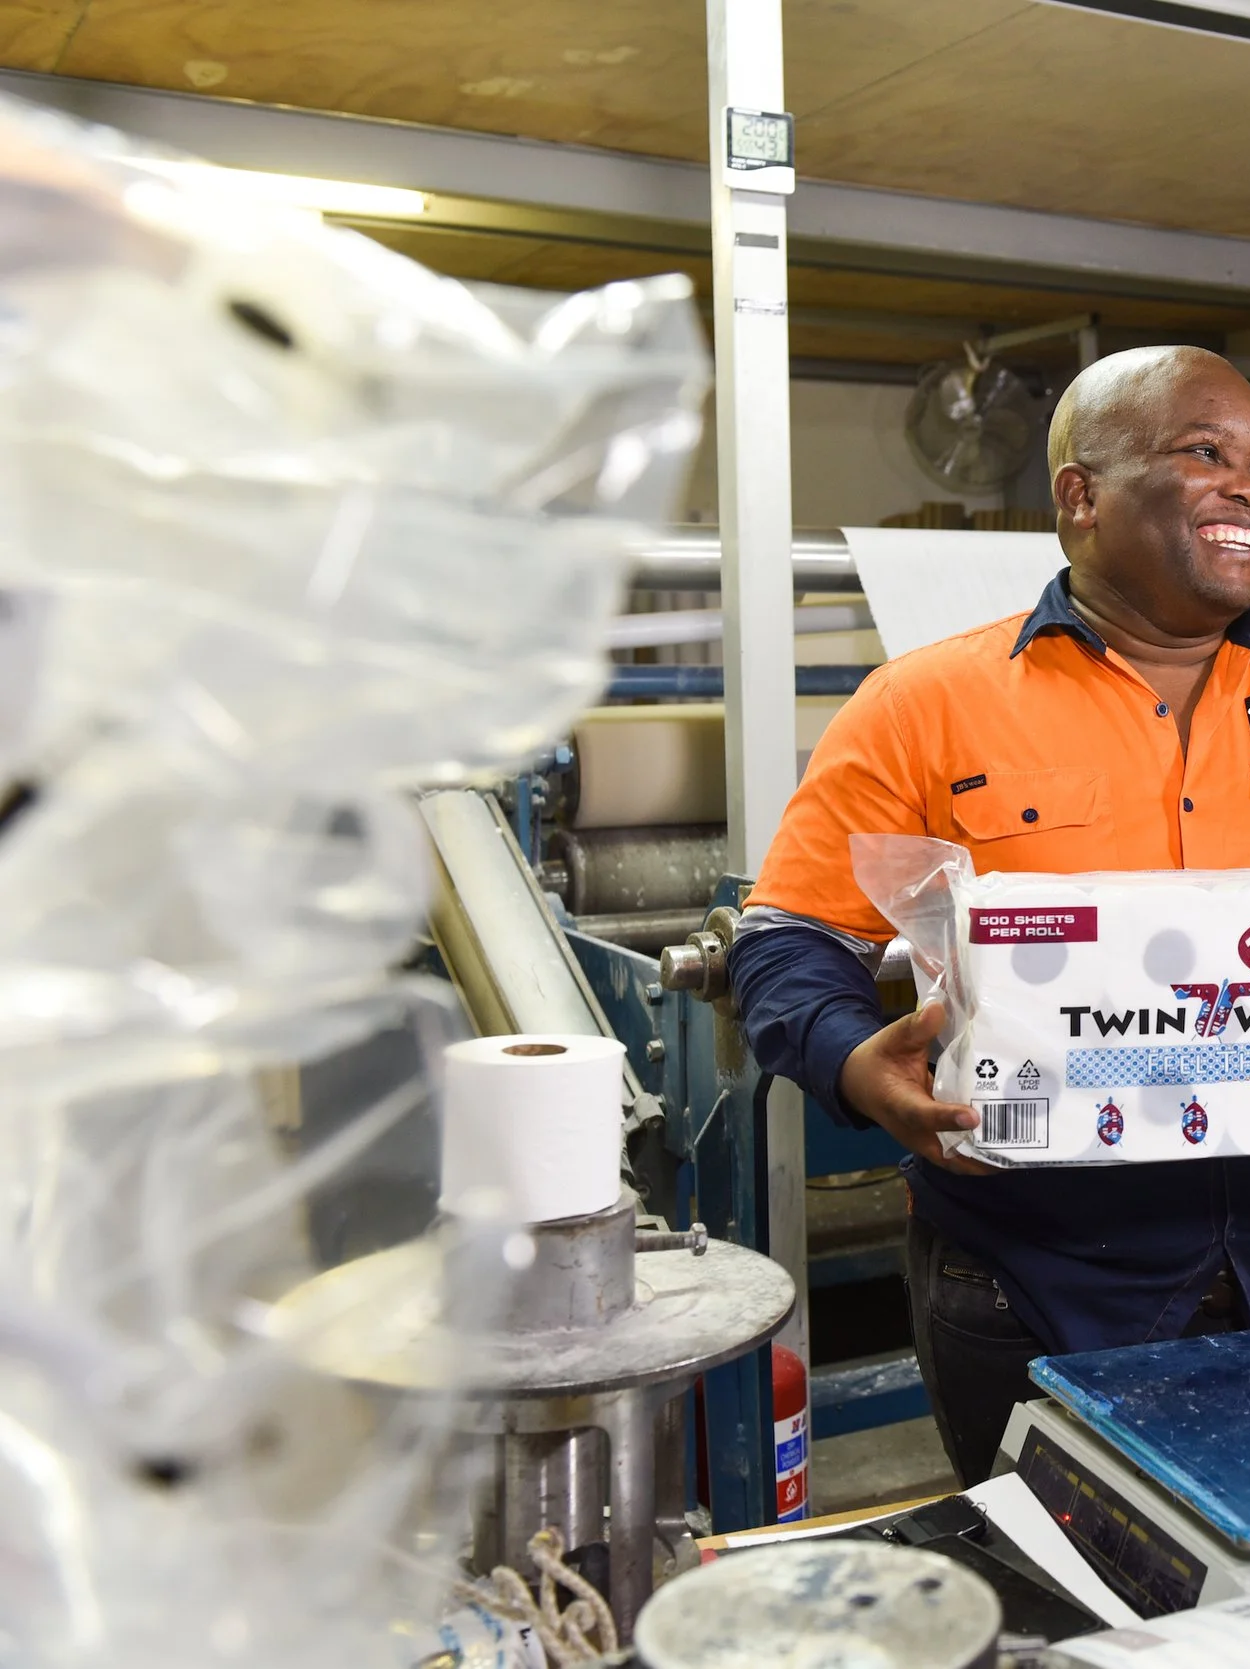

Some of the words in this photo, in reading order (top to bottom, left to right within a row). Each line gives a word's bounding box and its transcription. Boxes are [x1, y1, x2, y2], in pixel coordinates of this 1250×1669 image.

[979, 916, 1009, 925] 500
[1014, 915, 1075, 925] SHEETS
[989, 928, 1020, 937] PER
[1025, 927, 1065, 936] ROLL
[1060, 1006, 1187, 1037] TWIN
[1147, 1052, 1206, 1077] FEEL
